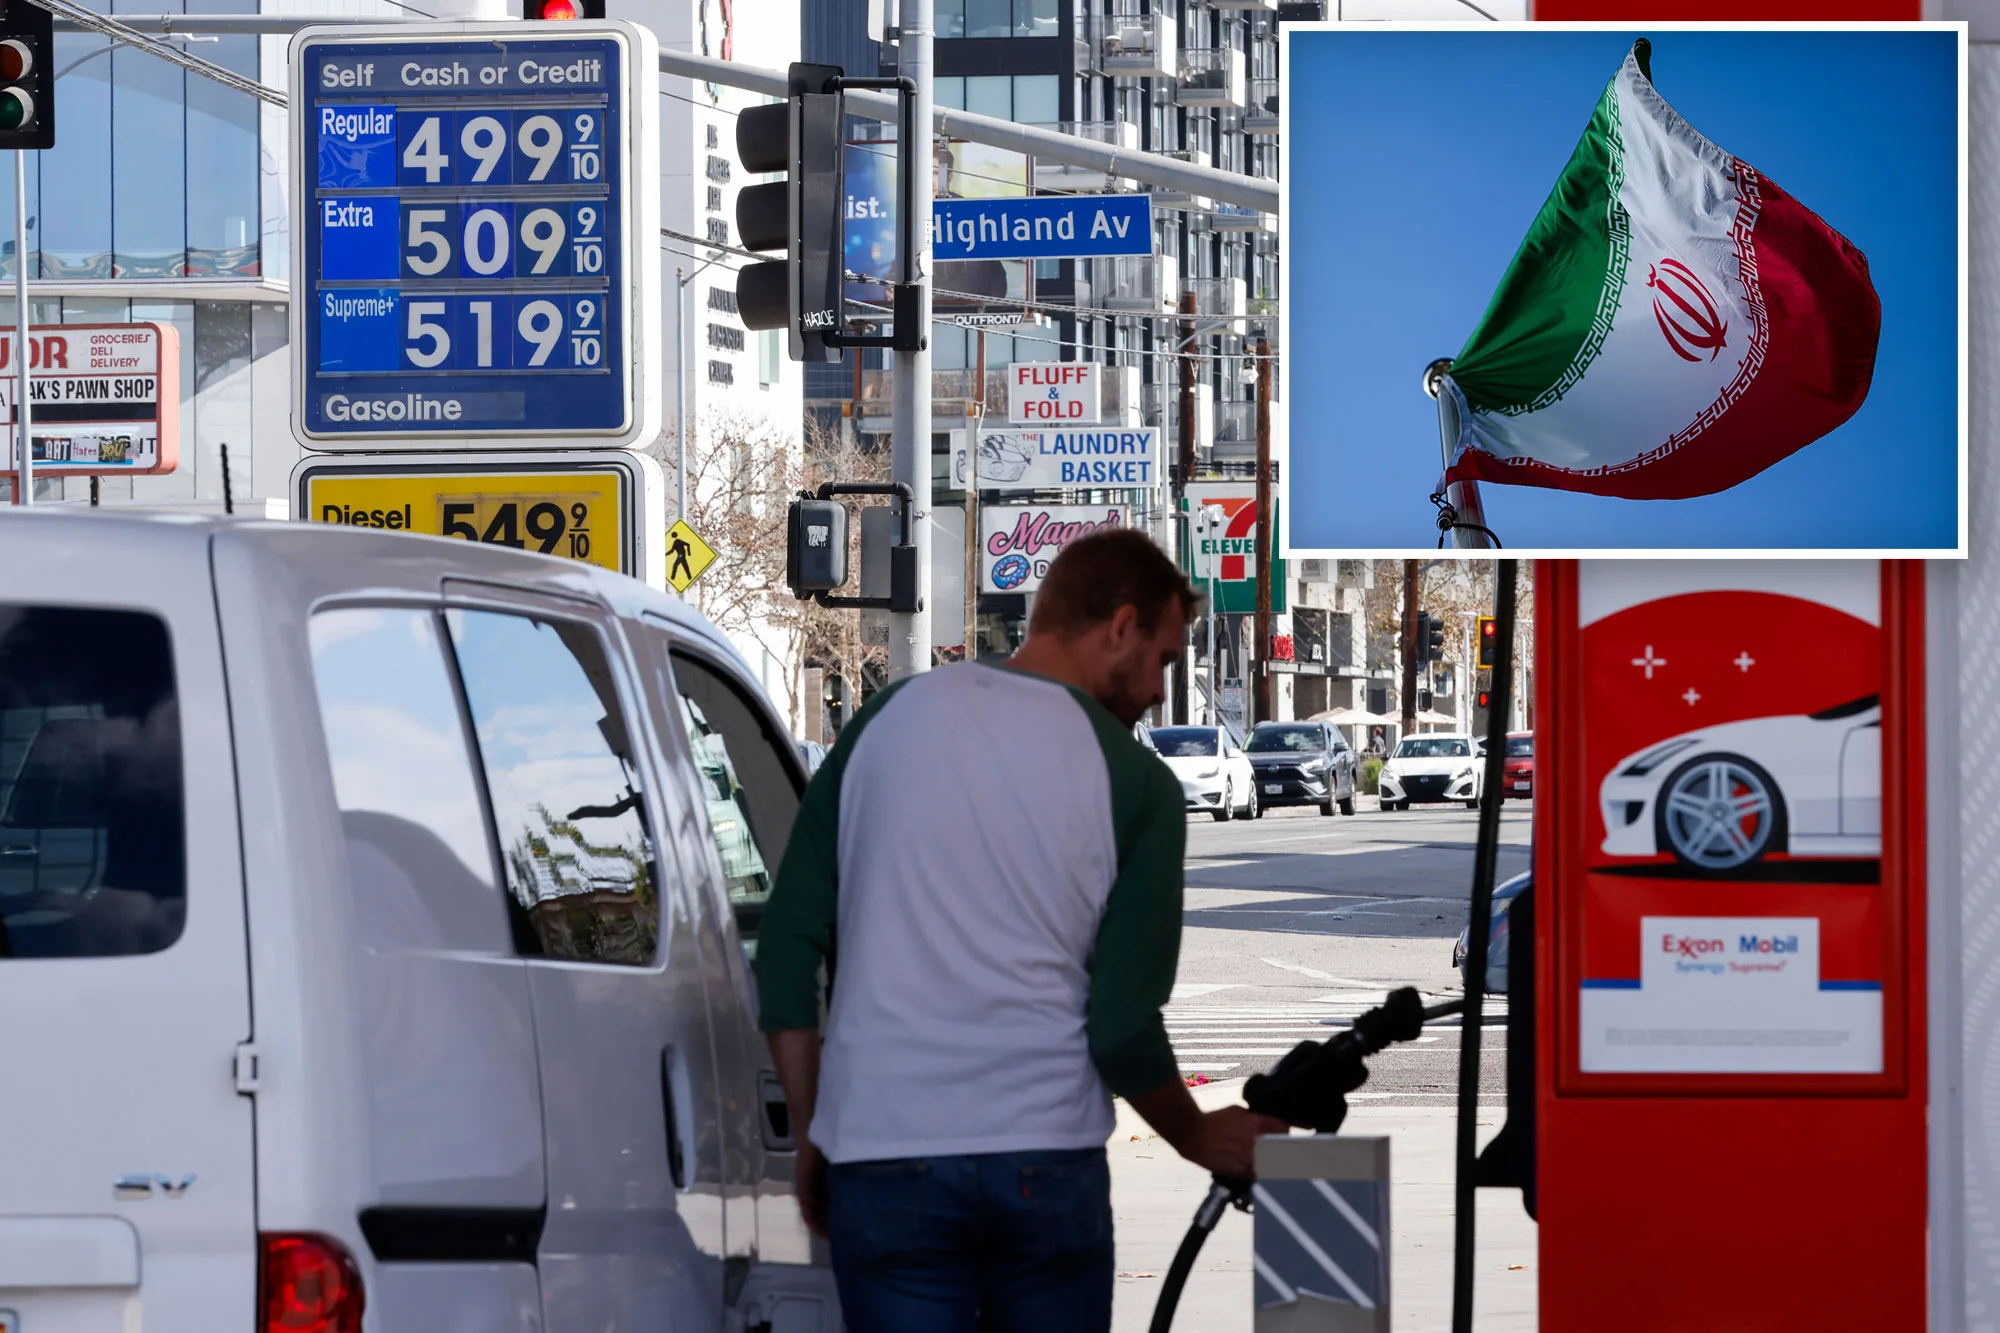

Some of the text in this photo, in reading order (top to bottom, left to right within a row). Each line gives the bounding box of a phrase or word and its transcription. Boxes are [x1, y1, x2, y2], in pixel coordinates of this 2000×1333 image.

[322, 59, 601, 88] Self Cash or Credit
[322, 108, 393, 142] Regular
[325, 201, 373, 227] Extra
[845, 195, 888, 219] ist.
[933, 210, 1131, 252] Highland Av
[325, 293, 394, 323] Supreme+
[90, 334, 151, 344] GROCERIES
[90, 346, 113, 356] DELI
[90, 357, 140, 368] DELIVERY
[1018, 366, 1088, 385] FLUFF
[30, 378, 155, 400] AK'S PAWN SHOP
[1048, 386, 1059, 400] &
[326, 393, 462, 422] Gasoline
[1024, 400, 1083, 419] FOLD
[45, 440, 70, 461] ART
[1039, 433, 1151, 455] LAUNDRY
[1062, 461, 1151, 483] BASKET
[322, 504, 411, 530] Diesel
[1201, 538, 1257, 554] ELEVE
[1662, 934, 1798, 959] Exxon Mobil
